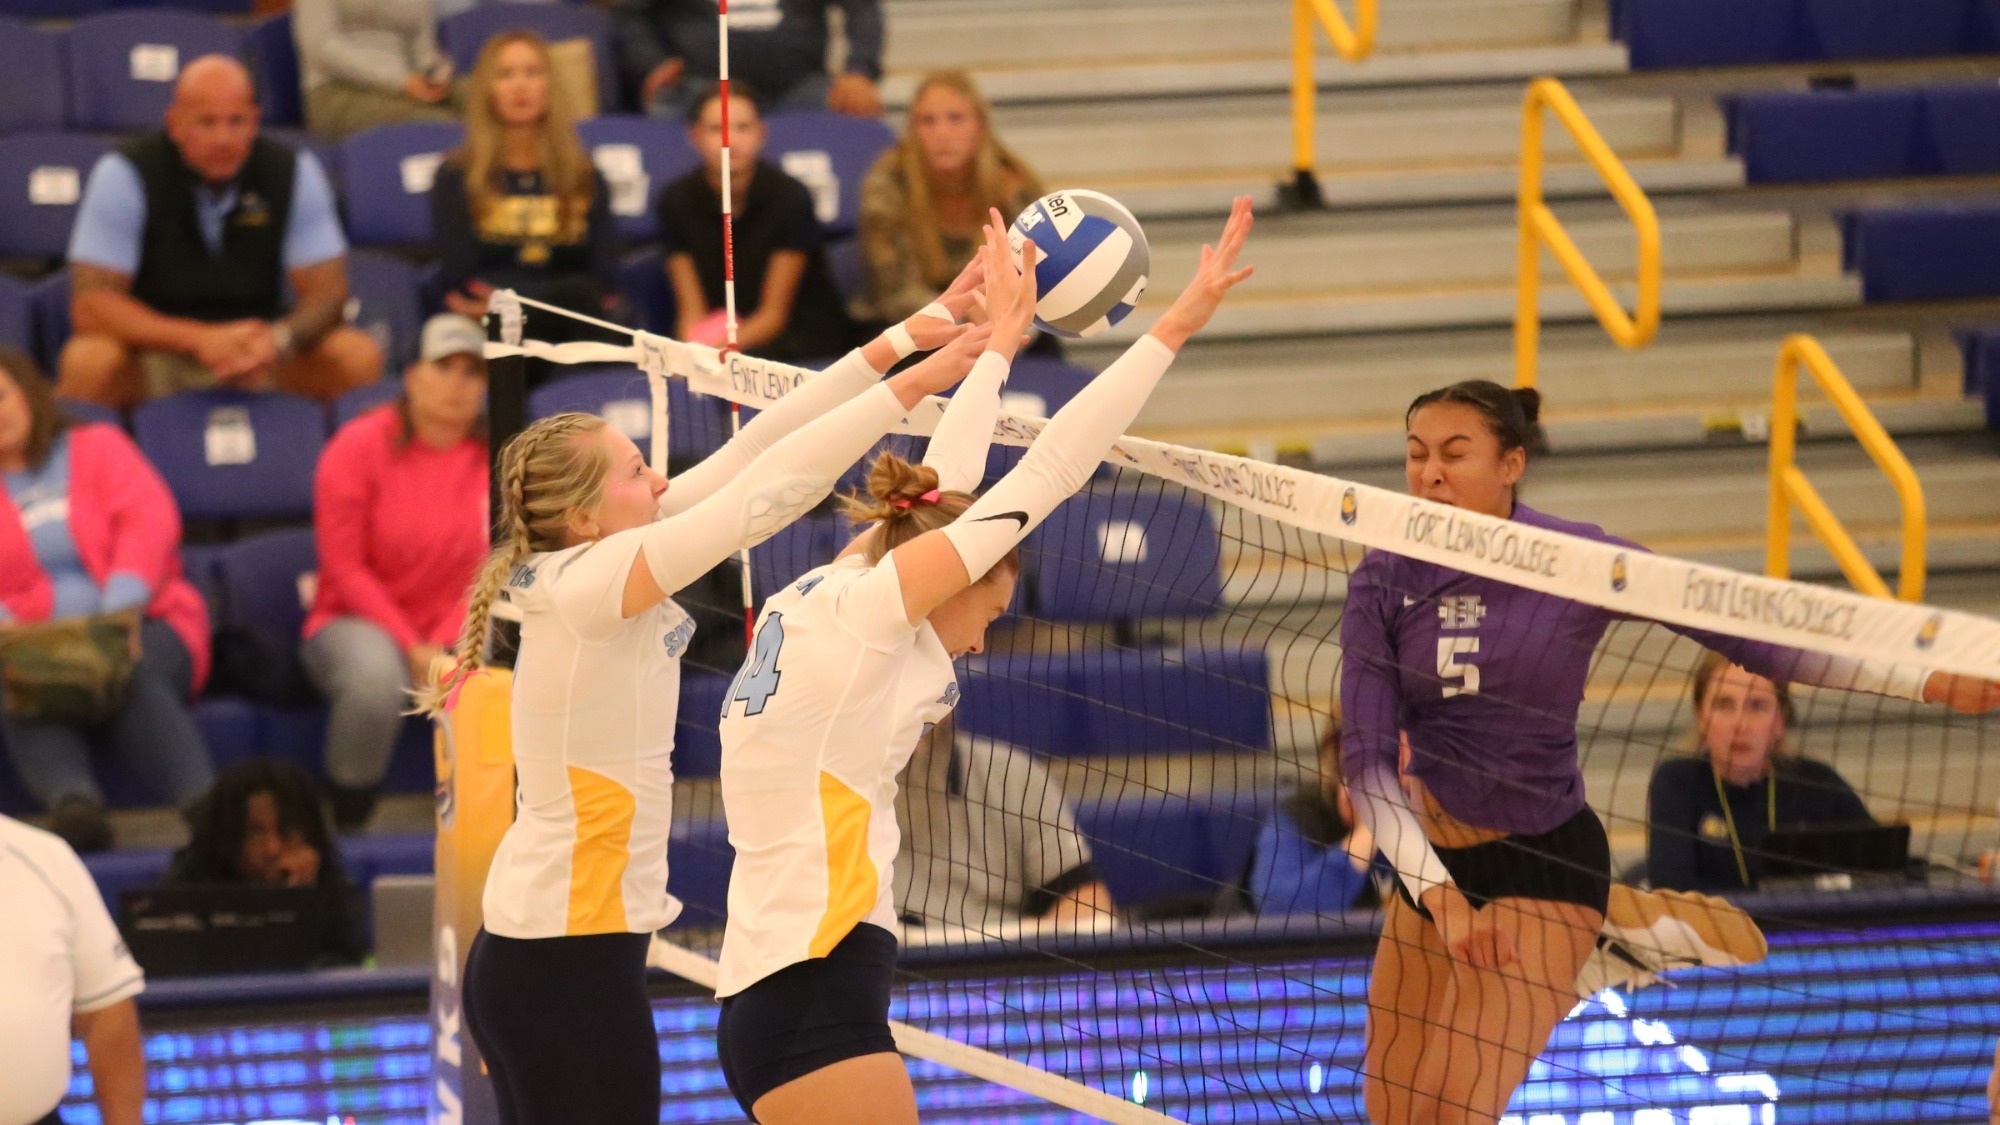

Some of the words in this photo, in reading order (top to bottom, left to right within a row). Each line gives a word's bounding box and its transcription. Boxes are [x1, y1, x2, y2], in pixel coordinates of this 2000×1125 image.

[1048, 194, 1068, 217] ten
[1404, 502, 1444, 549] FORT
[1445, 513, 1488, 560] LEWIS
[1489, 524, 1561, 577] COLLEGE
[1681, 568, 1727, 615] FORT
[722, 610, 785, 718] 14
[1437, 636, 1480, 699] 5
